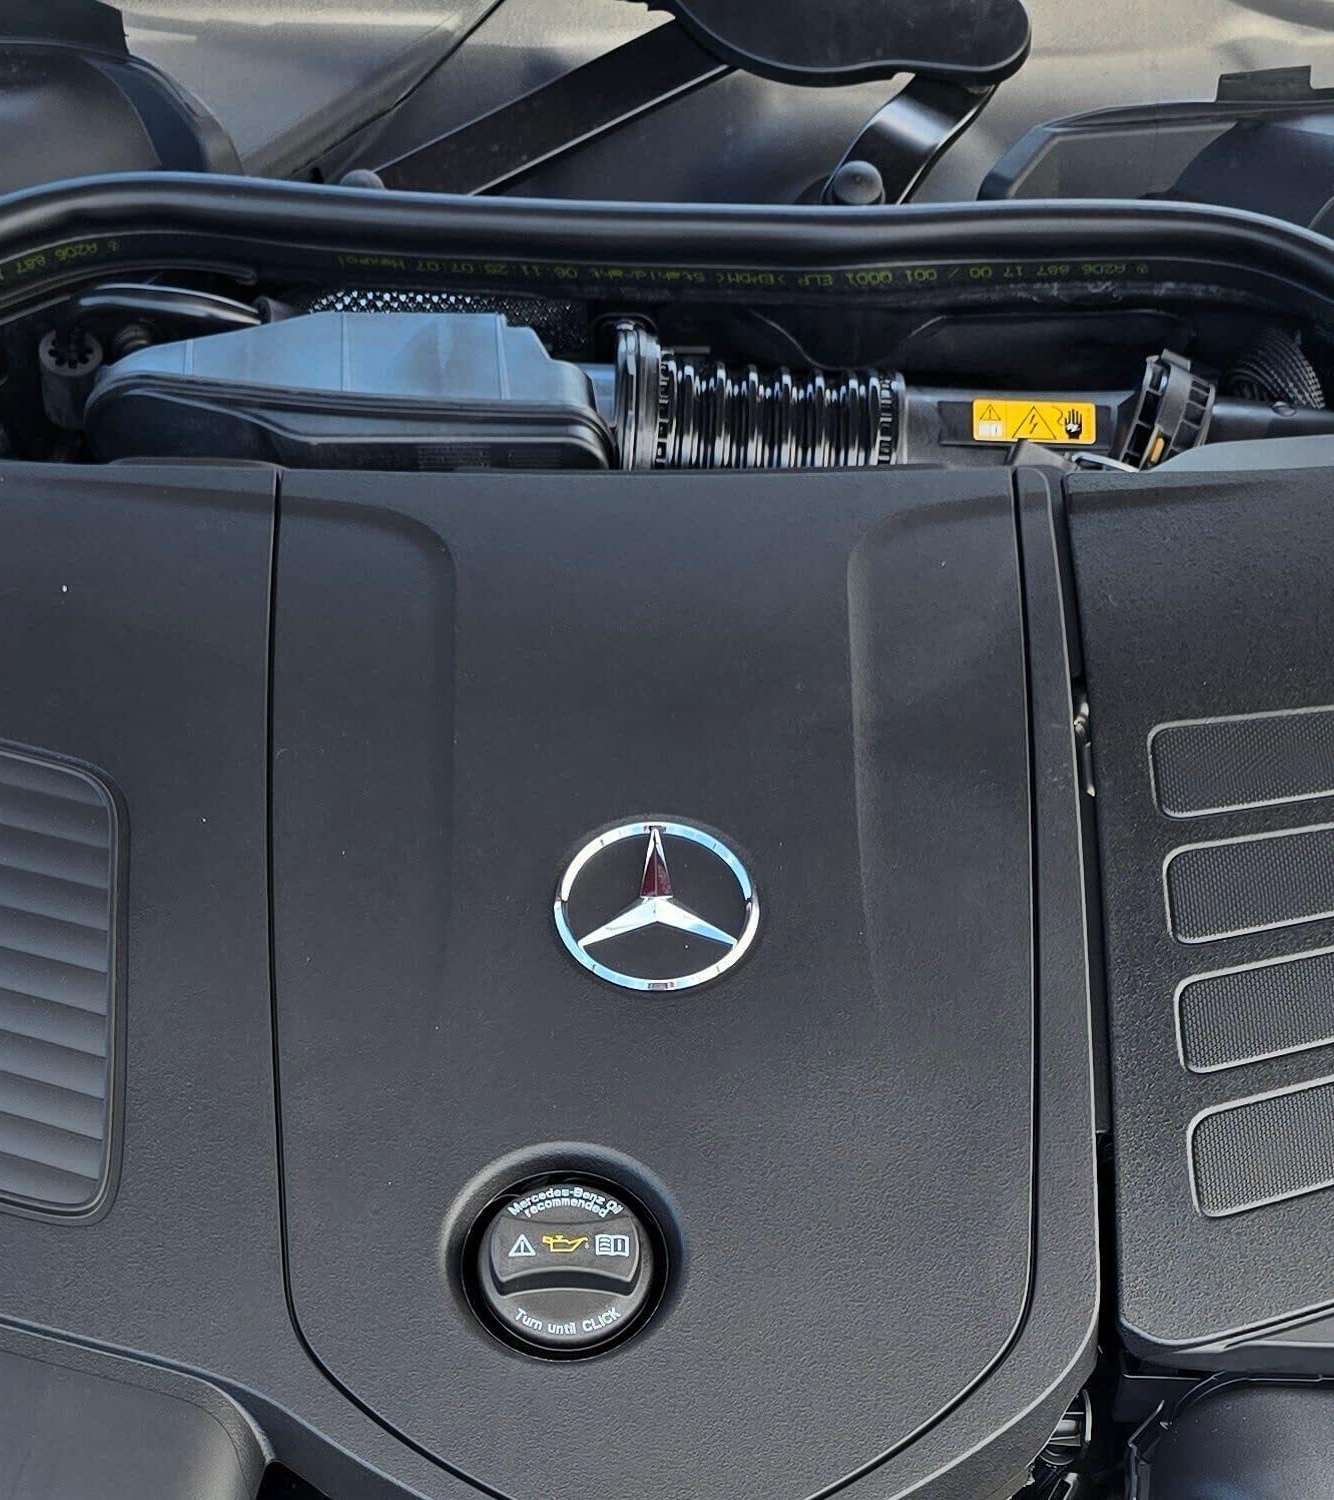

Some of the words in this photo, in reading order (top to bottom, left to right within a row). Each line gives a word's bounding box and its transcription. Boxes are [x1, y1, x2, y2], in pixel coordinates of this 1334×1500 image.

[507, 1187, 606, 1217] Mercedes-Benz
[607, 1199, 624, 1216] Oil
[524, 1197, 611, 1218] recommended
[515, 1307, 543, 1331] Turn
[547, 1322, 577, 1335] until
[582, 1306, 622, 1332] CLICK
